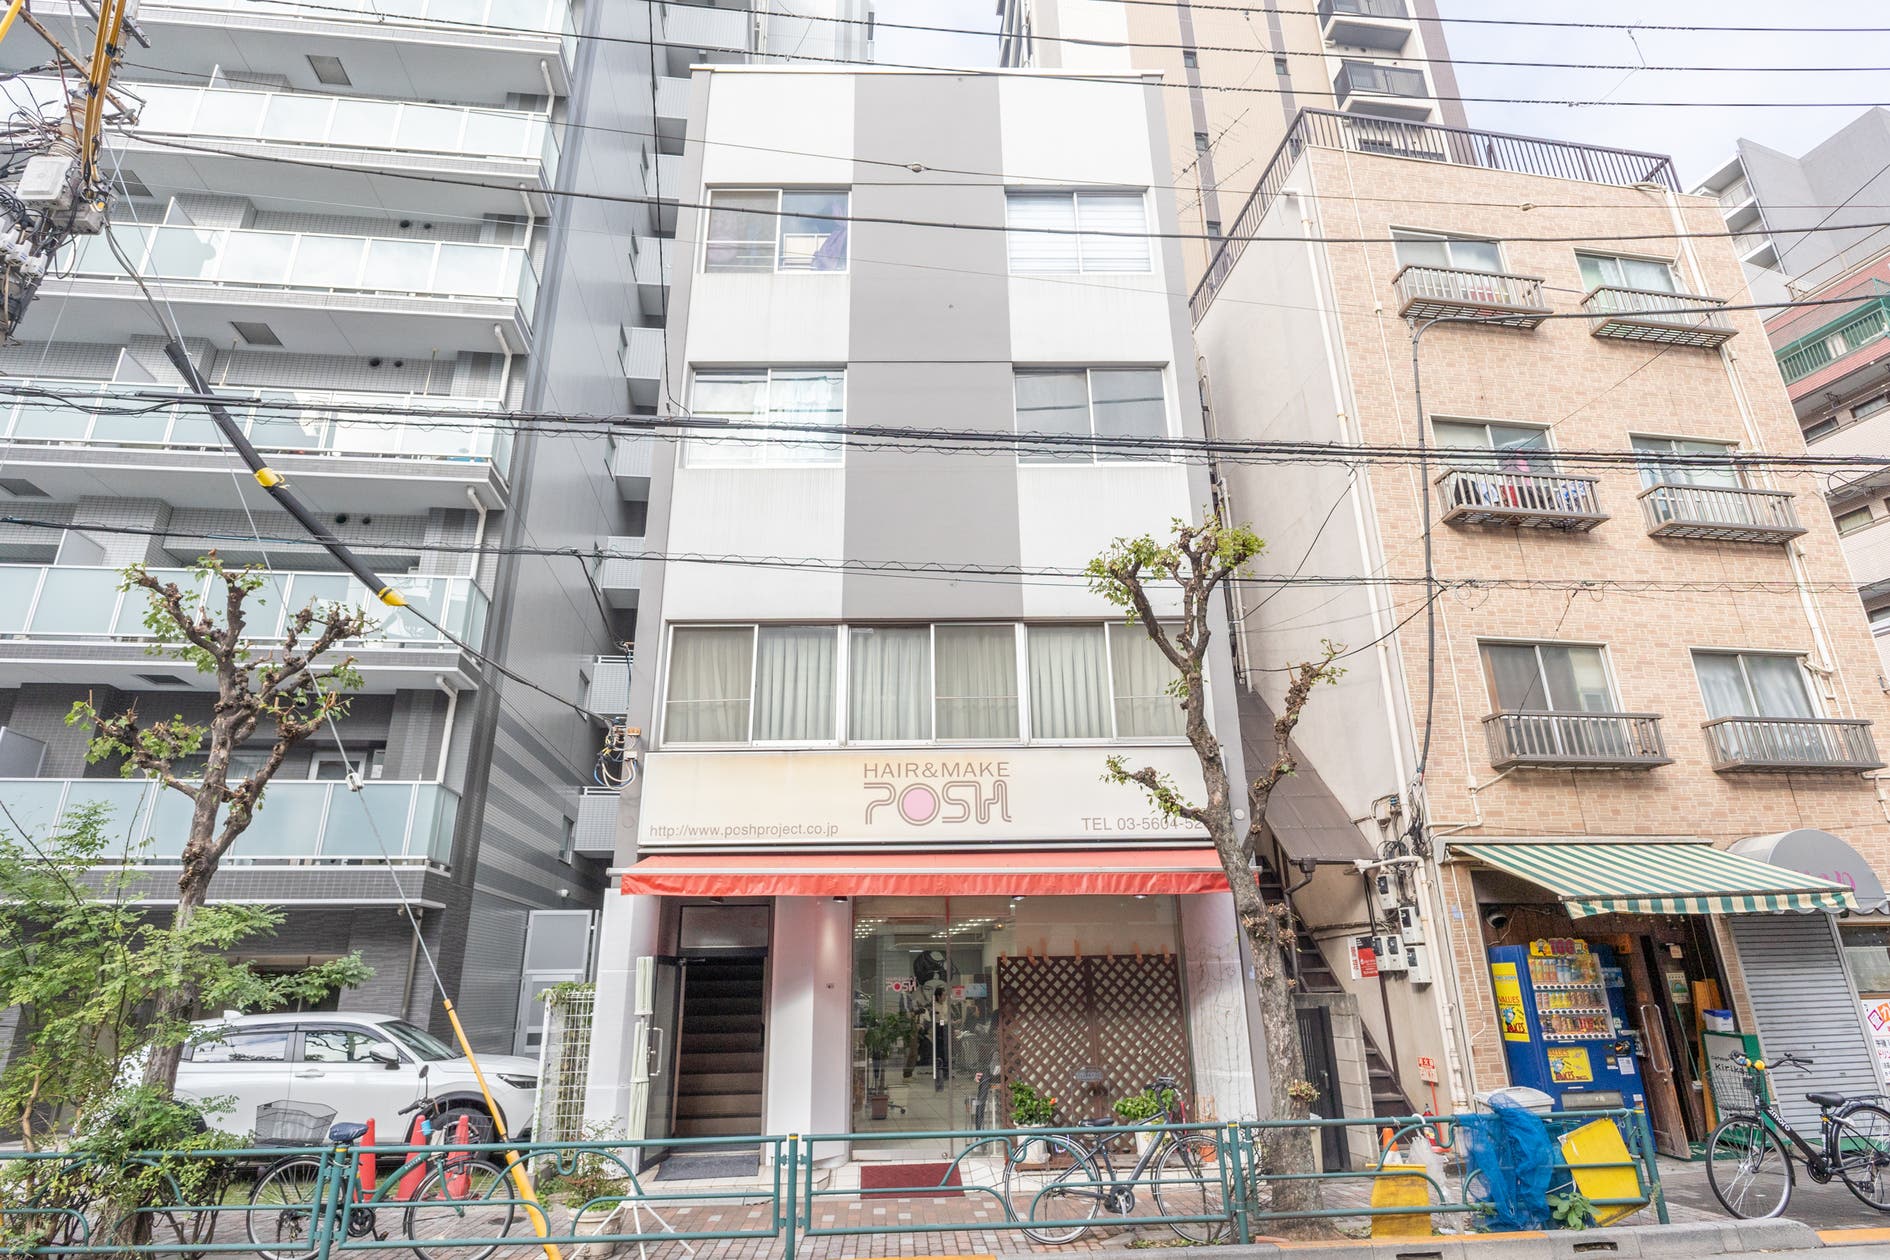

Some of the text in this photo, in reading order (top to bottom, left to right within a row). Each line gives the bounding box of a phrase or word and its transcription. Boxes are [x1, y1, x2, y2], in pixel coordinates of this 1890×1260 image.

[863, 762, 1010, 779] HAIR&MAKE
[863, 779, 1012, 827] POSH
[649, 823, 839, 839] http://www.poshproject.co.jp
[1081, 817, 1203, 831] TEL 03-5604-52
